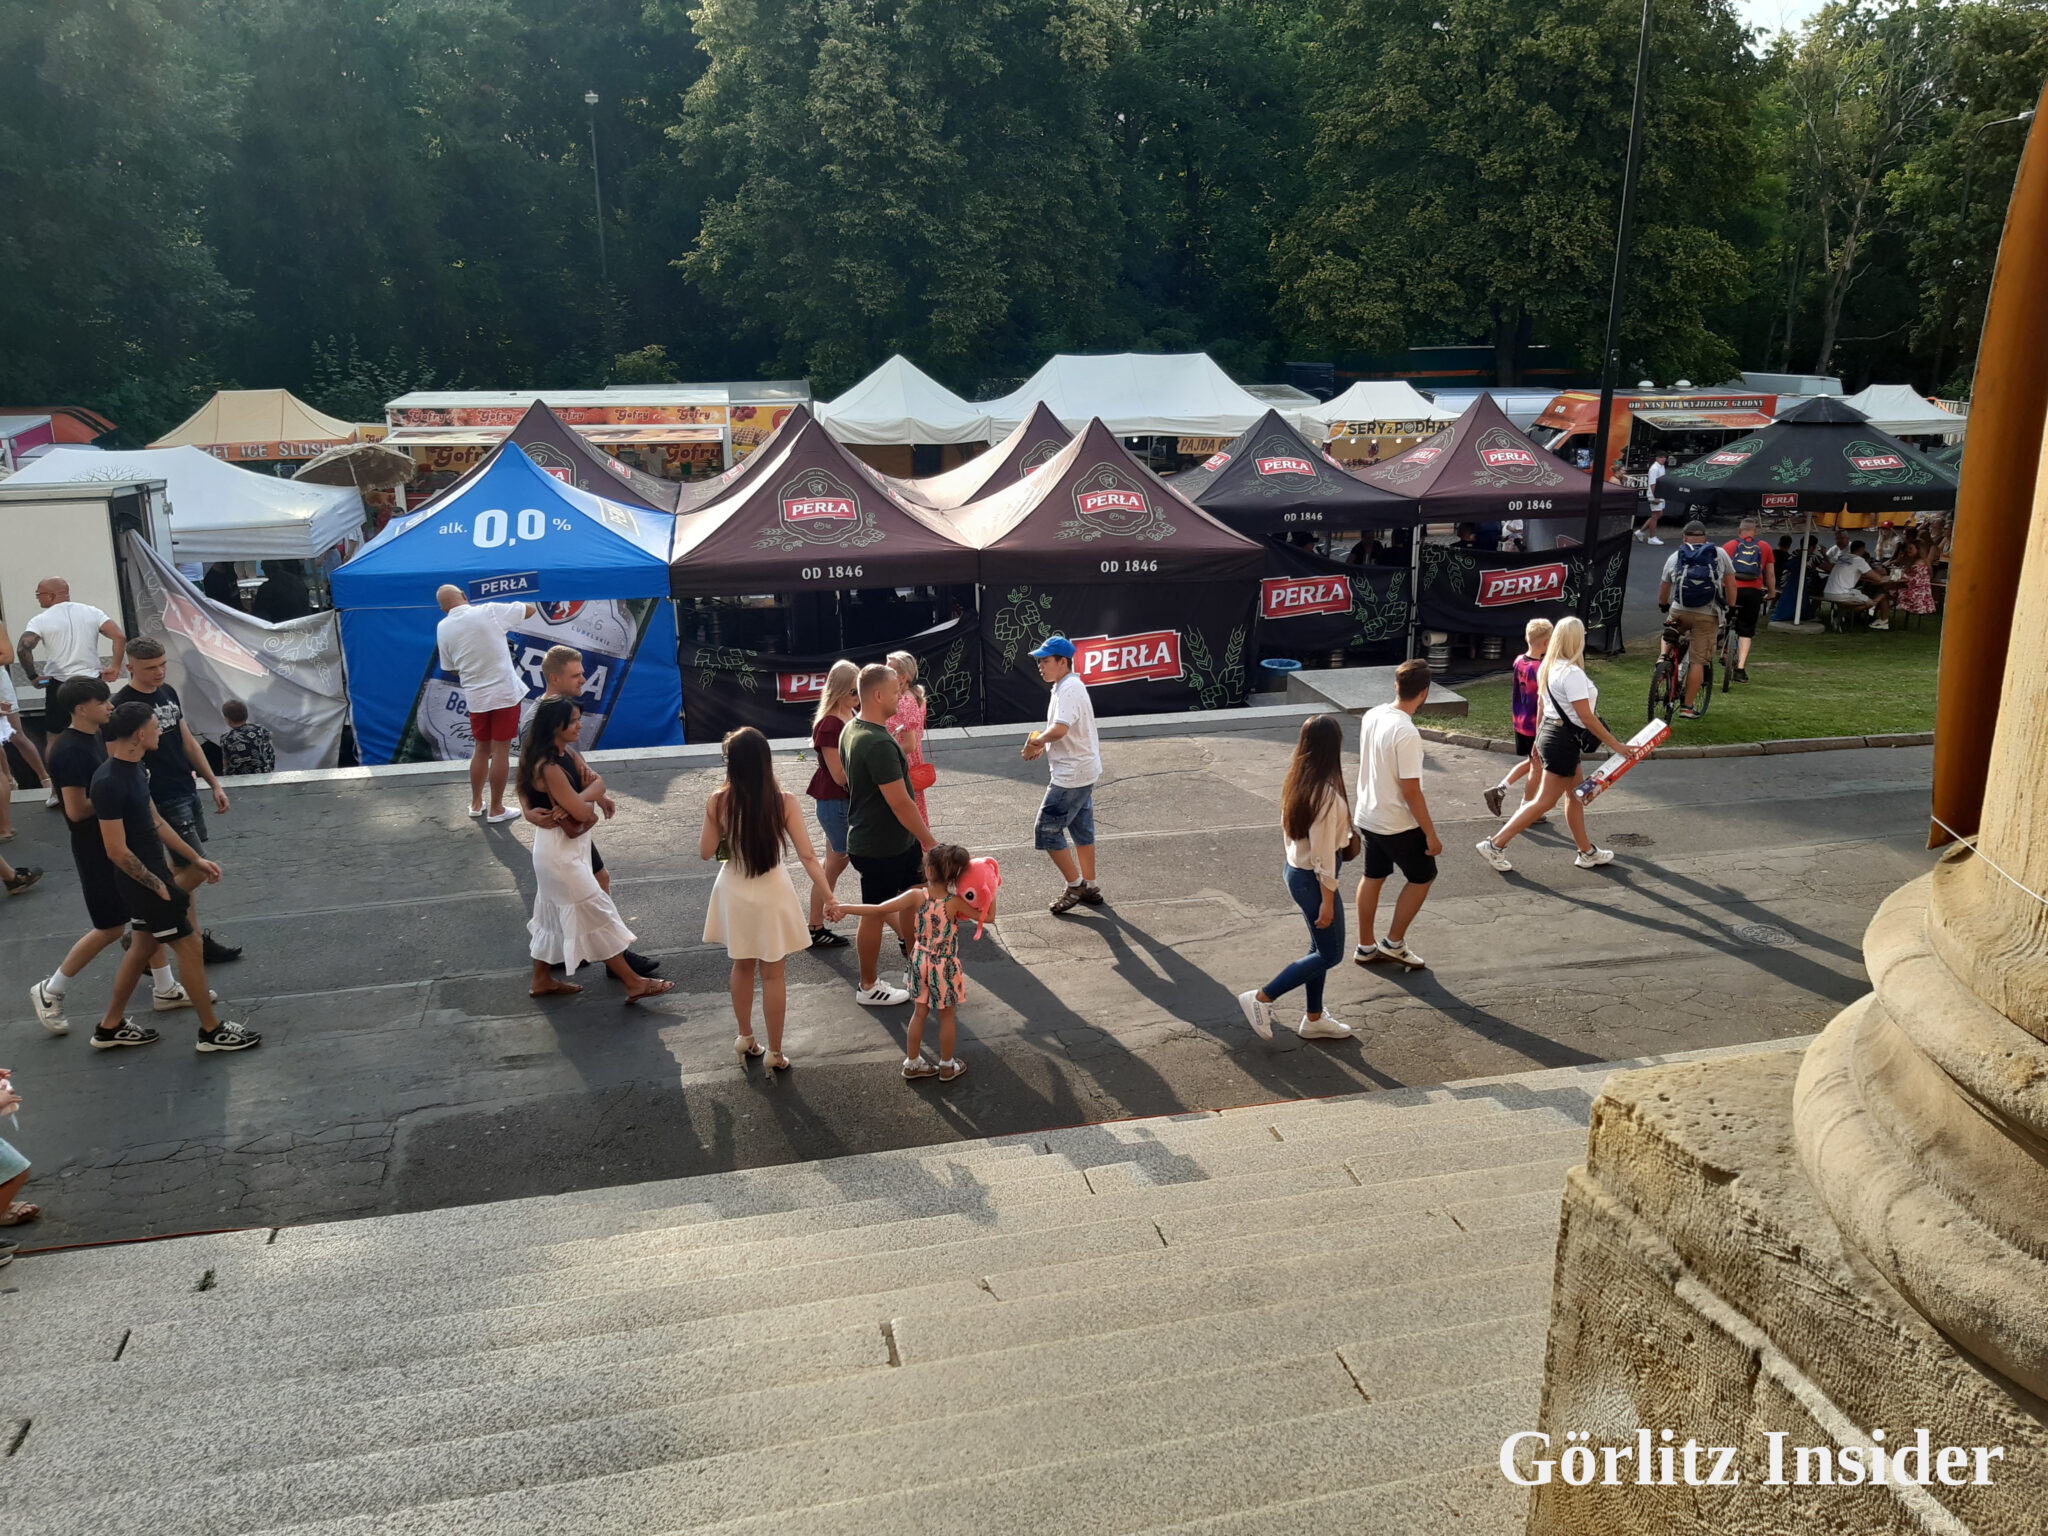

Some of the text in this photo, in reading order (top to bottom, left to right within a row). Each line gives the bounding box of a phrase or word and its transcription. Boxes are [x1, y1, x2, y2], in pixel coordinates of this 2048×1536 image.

[1644, 401, 1660, 409] NAS
[1682, 400, 1728, 408] WYJDZIESZ
[1732, 399, 1764, 408] GŁODNY
[407, 408, 445, 424] Gofry
[478, 408, 513, 422] Gofry
[614, 408, 649, 421] Gofry
[677, 408, 711, 421] Gofry
[1348, 421, 1386, 435] SERY
[240, 444, 268, 458] ICE
[430, 446, 484, 467] Gofr
[1489, 452, 1531, 462] PERŁA
[1264, 460, 1310, 471] PERŁA
[1858, 456, 1898, 467] PERŁA
[1086, 494, 1140, 509] PERŁA
[1508, 500, 1552, 511] OD 1846
[1765, 496, 1795, 505] PERŁA
[791, 502, 850, 516] PERŁA
[1284, 512, 1323, 522] OD 1846
[439, 508, 572, 548] alk. 0,0 %
[801, 565, 864, 580] OD 1846
[1100, 560, 1158, 573] OD 1846
[481, 577, 528, 595] PERŁA
[1486, 572, 1558, 598] PERŁA
[1270, 582, 1345, 609] PERŁA
[1083, 641, 1172, 676] PERŁA
